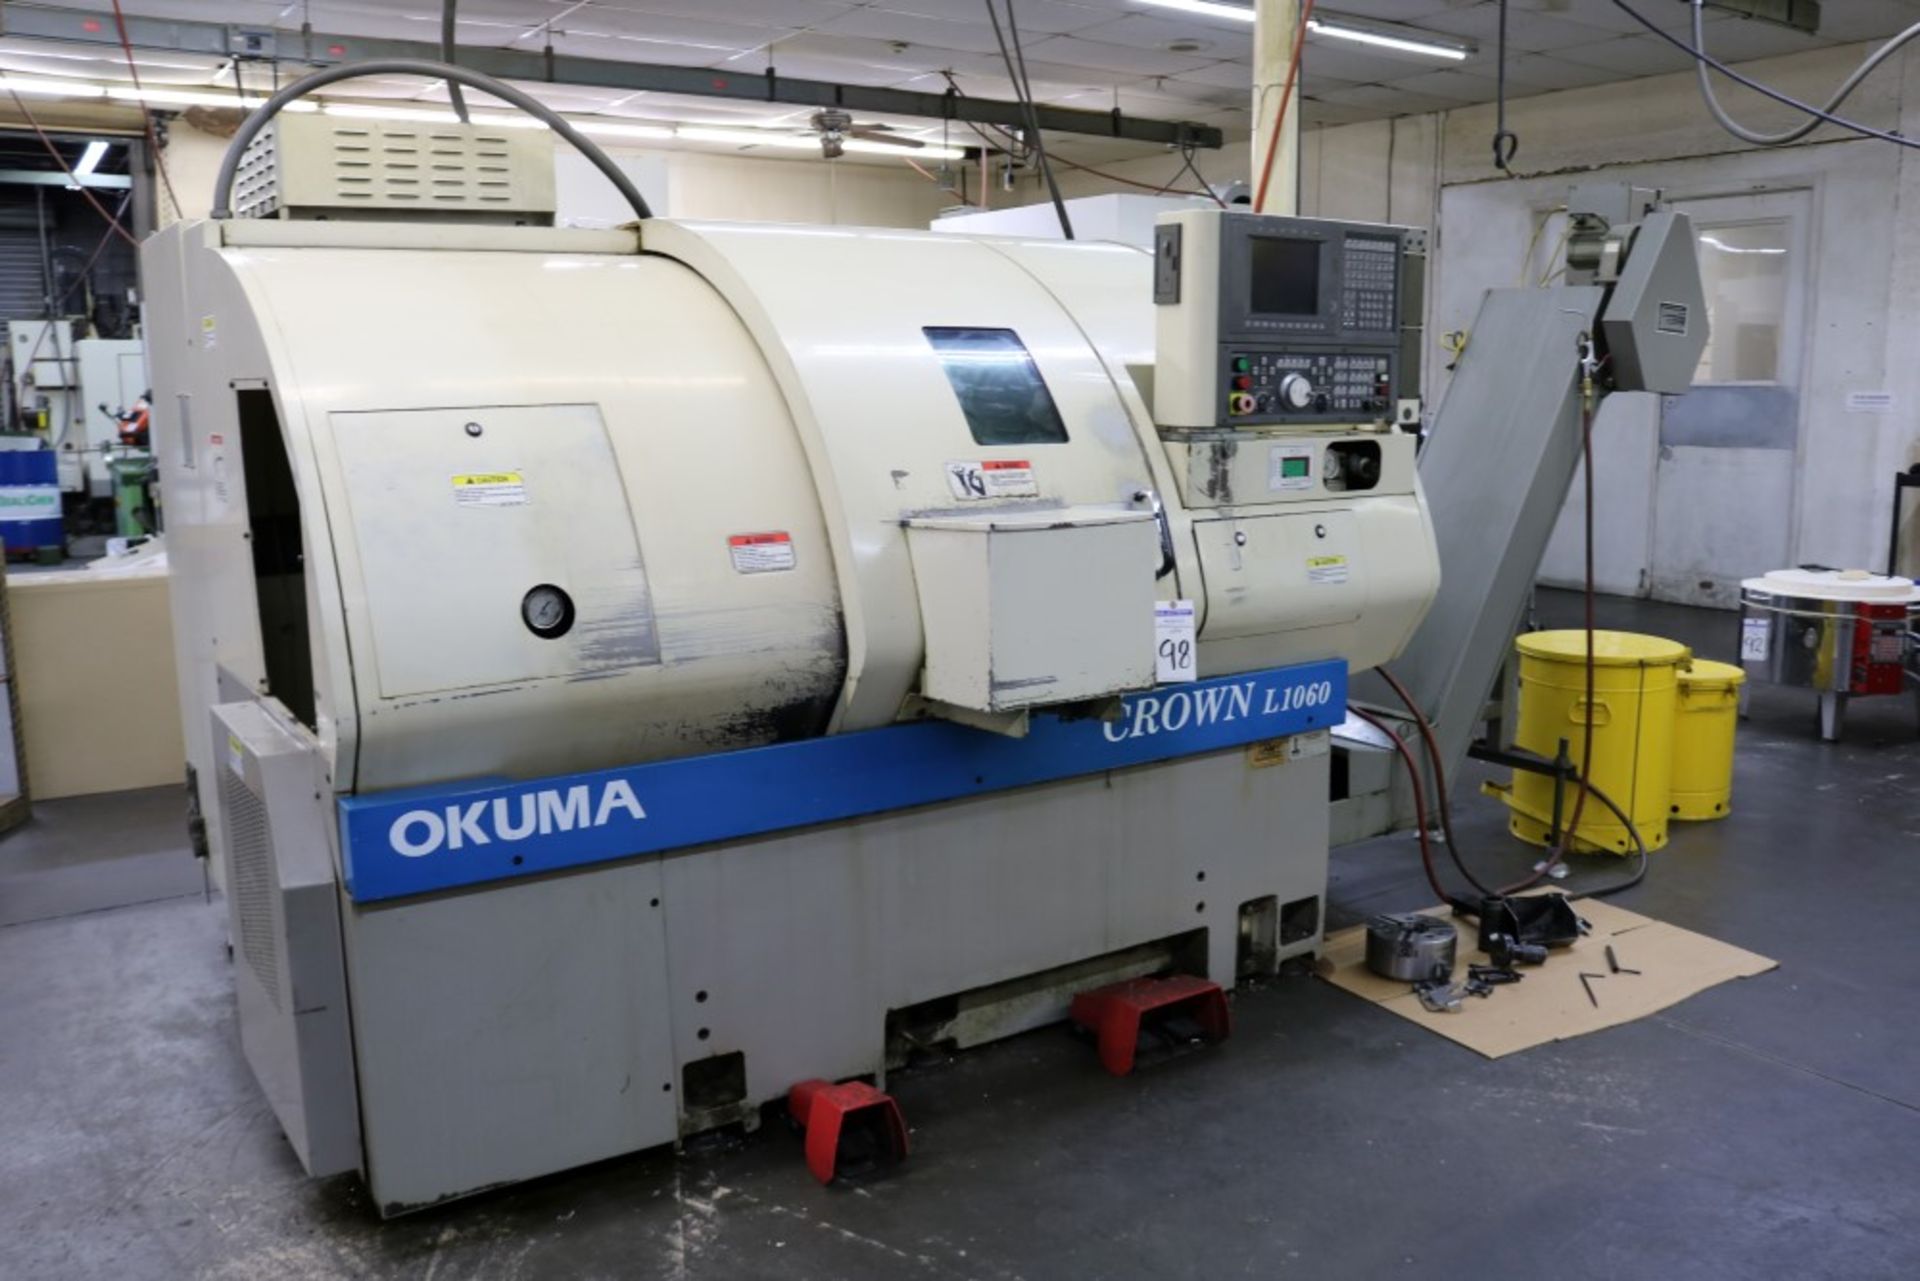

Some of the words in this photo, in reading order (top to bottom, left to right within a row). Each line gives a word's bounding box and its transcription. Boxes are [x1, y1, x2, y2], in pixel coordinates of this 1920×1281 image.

[1159, 639, 1191, 671] 98
[1262, 681, 1332, 715] L1060
[389, 779, 646, 857] OKUMA
